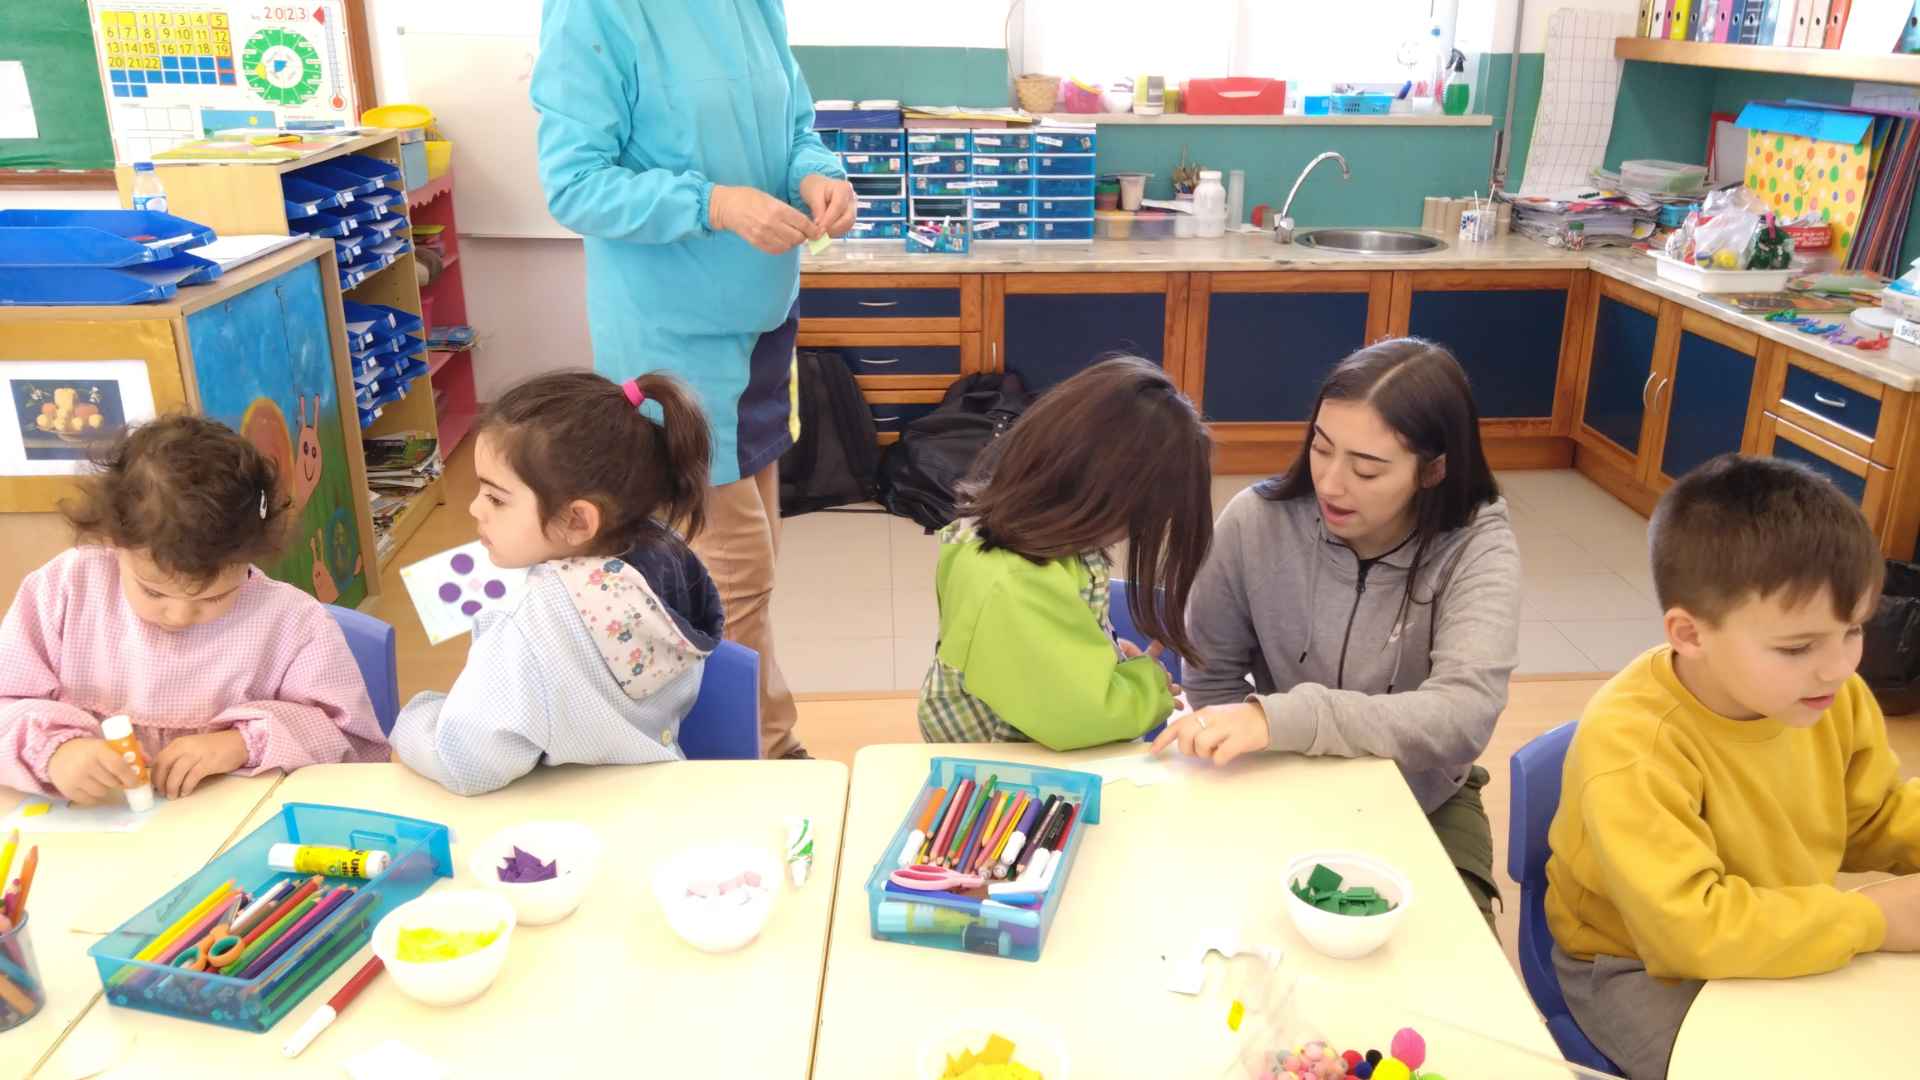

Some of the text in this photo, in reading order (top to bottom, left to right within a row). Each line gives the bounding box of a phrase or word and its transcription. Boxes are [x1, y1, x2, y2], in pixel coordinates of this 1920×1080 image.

[263, 6, 306, 20] 2023
[143, 14, 223, 26] 1 2 3 4 5
[107, 27, 227, 42] 6 7 8 9 10 11 12
[107, 42, 228, 54] 13 14 15 16 17 18 19
[110, 57, 158, 69] 20 21 22
